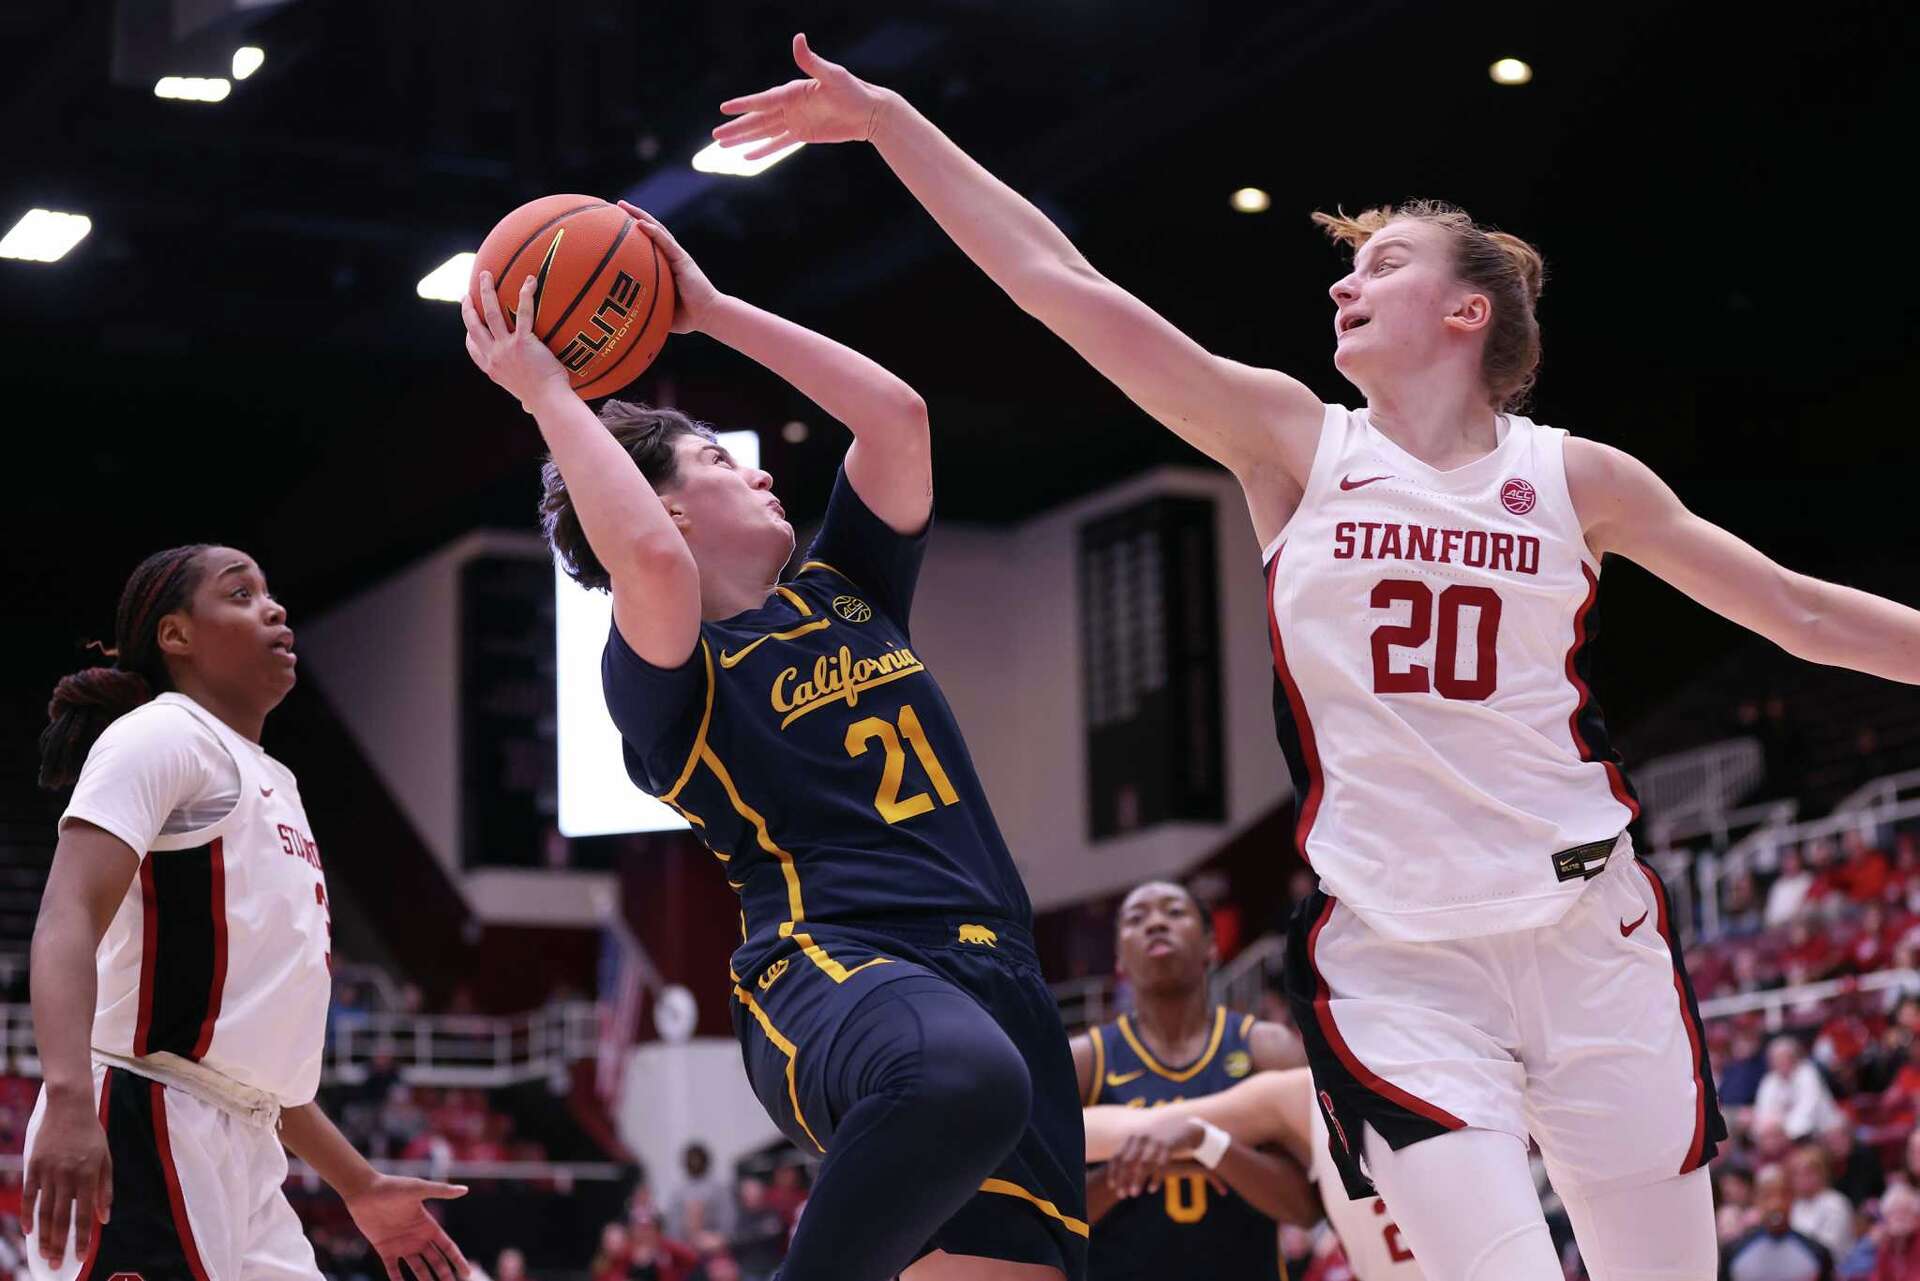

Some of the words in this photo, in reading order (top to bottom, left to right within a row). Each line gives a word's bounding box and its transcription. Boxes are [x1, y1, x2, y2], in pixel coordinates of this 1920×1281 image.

[556, 269, 641, 373] ELITE
[1505, 489, 1533, 500] ACC
[1334, 522, 1540, 575] STANFORD
[771, 642, 922, 715] California
[1370, 579, 1502, 701] 20
[843, 705, 960, 824] 21
